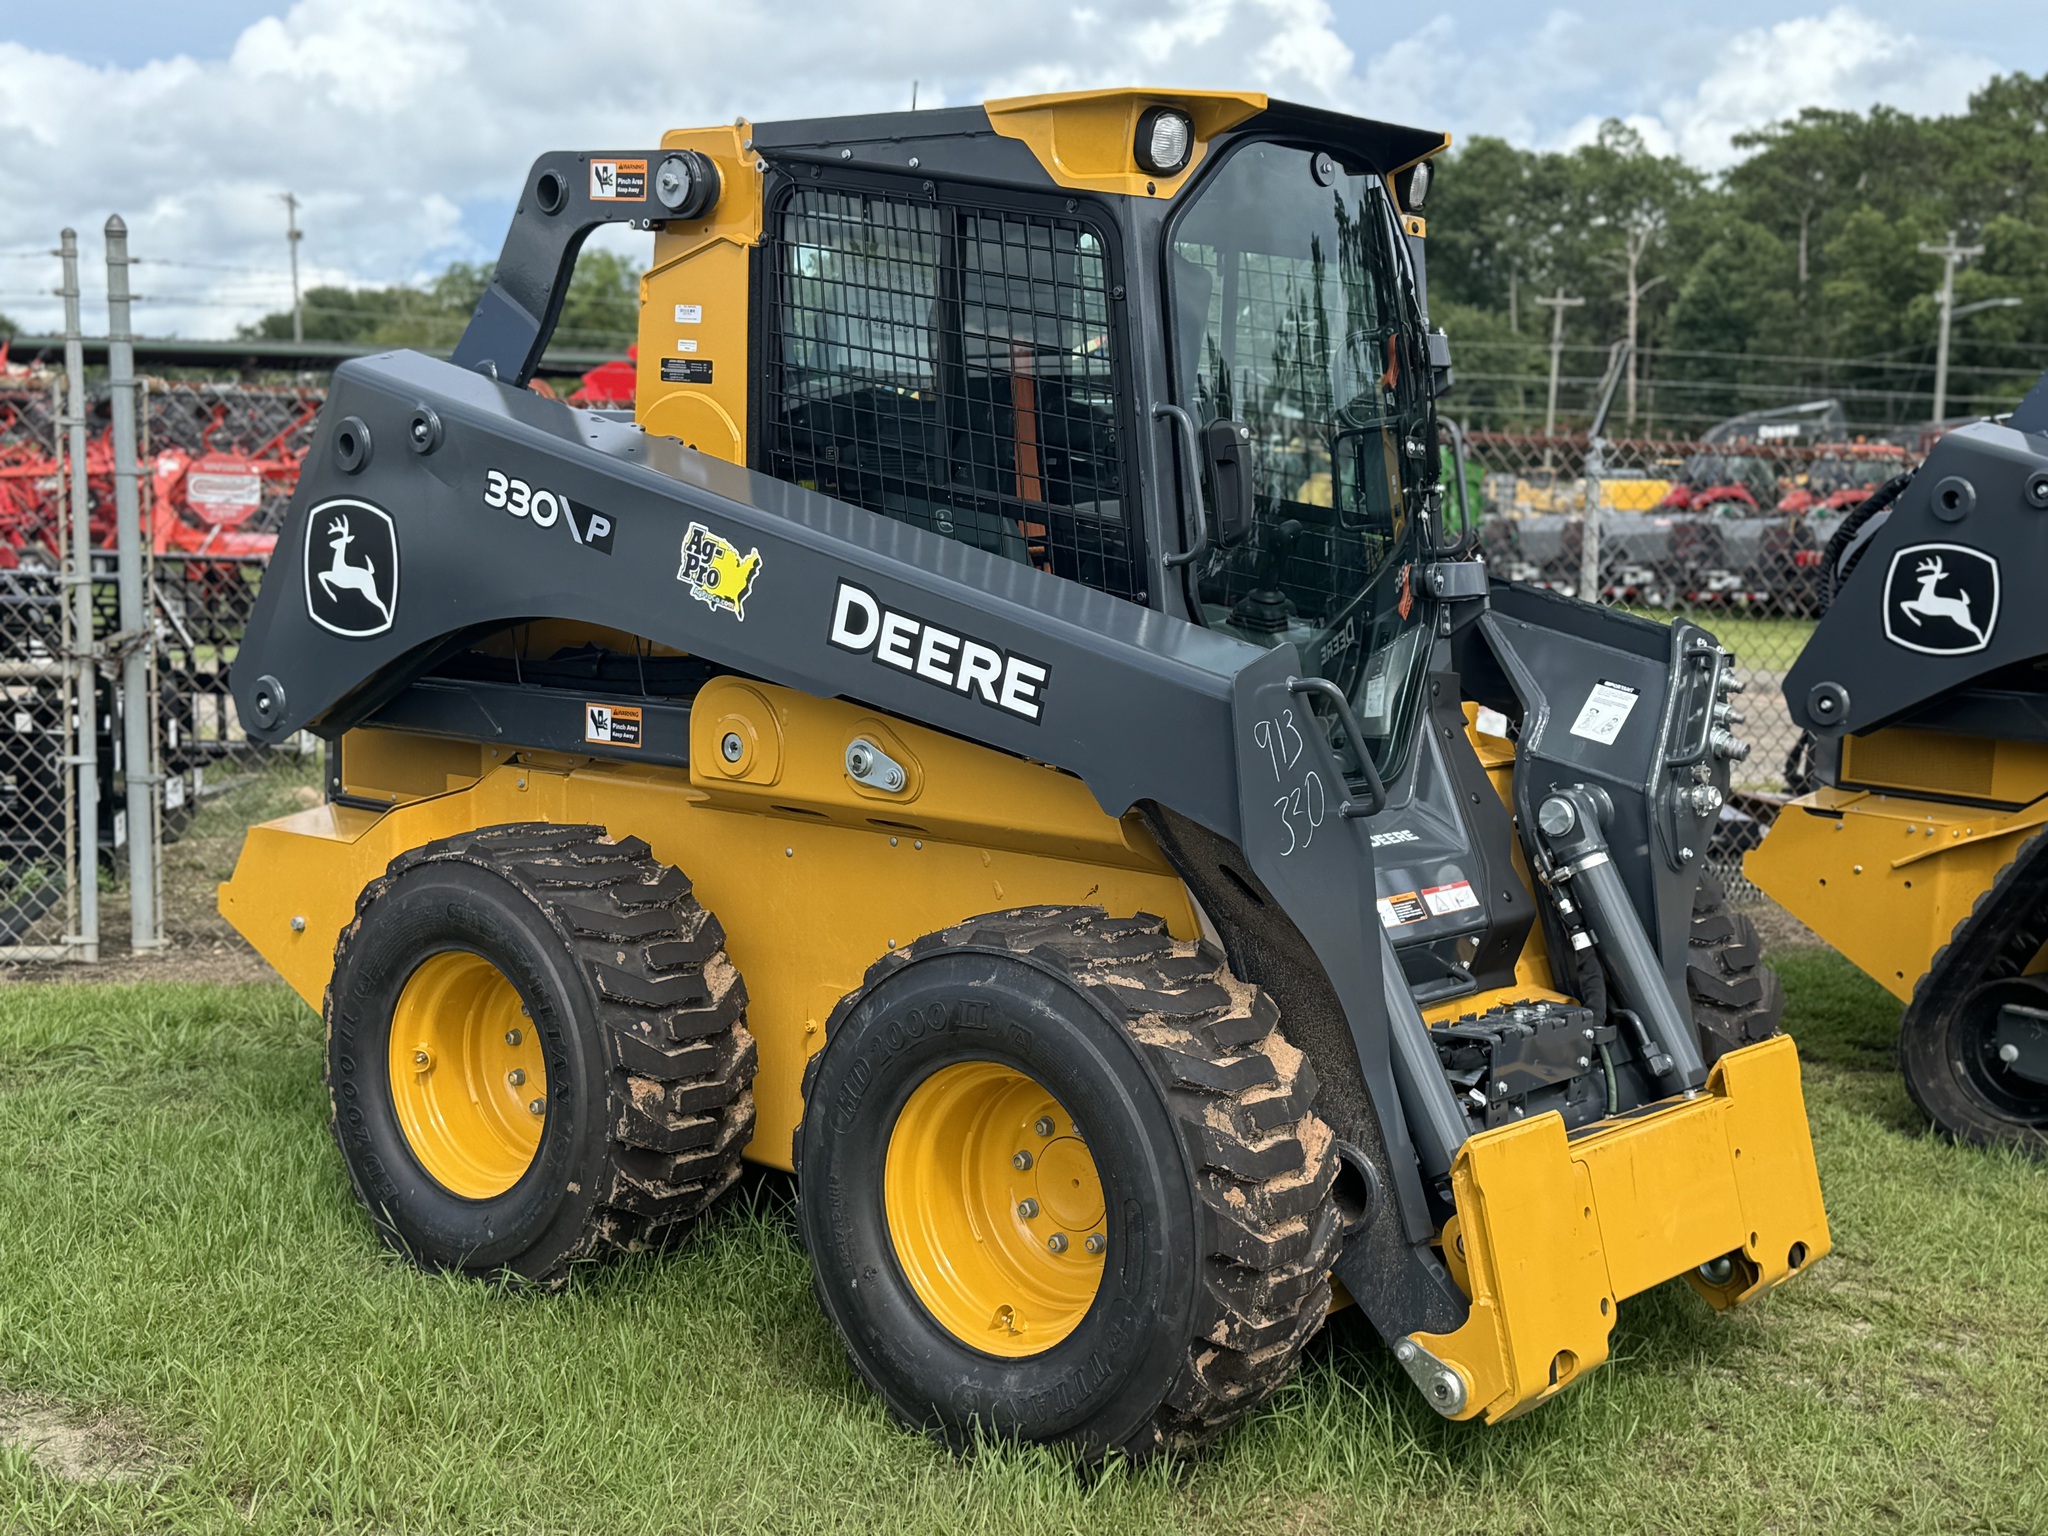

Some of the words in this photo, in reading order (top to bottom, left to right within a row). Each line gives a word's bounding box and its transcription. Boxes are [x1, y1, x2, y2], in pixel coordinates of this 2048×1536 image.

[484, 470, 559, 528] 330
[682, 554, 720, 587] Pro
[686, 528, 723, 564] Ag-
[831, 583, 1047, 719] DEERE
[612, 723, 626, 731] Pinch
[627, 724, 638, 732] Area
[612, 731, 622, 739] Keep
[623, 732, 635, 740] Away
[1253, 708, 1303, 783] 913
[870, 1001, 948, 1066] 2000
[340, 1054, 371, 1148] 2000
